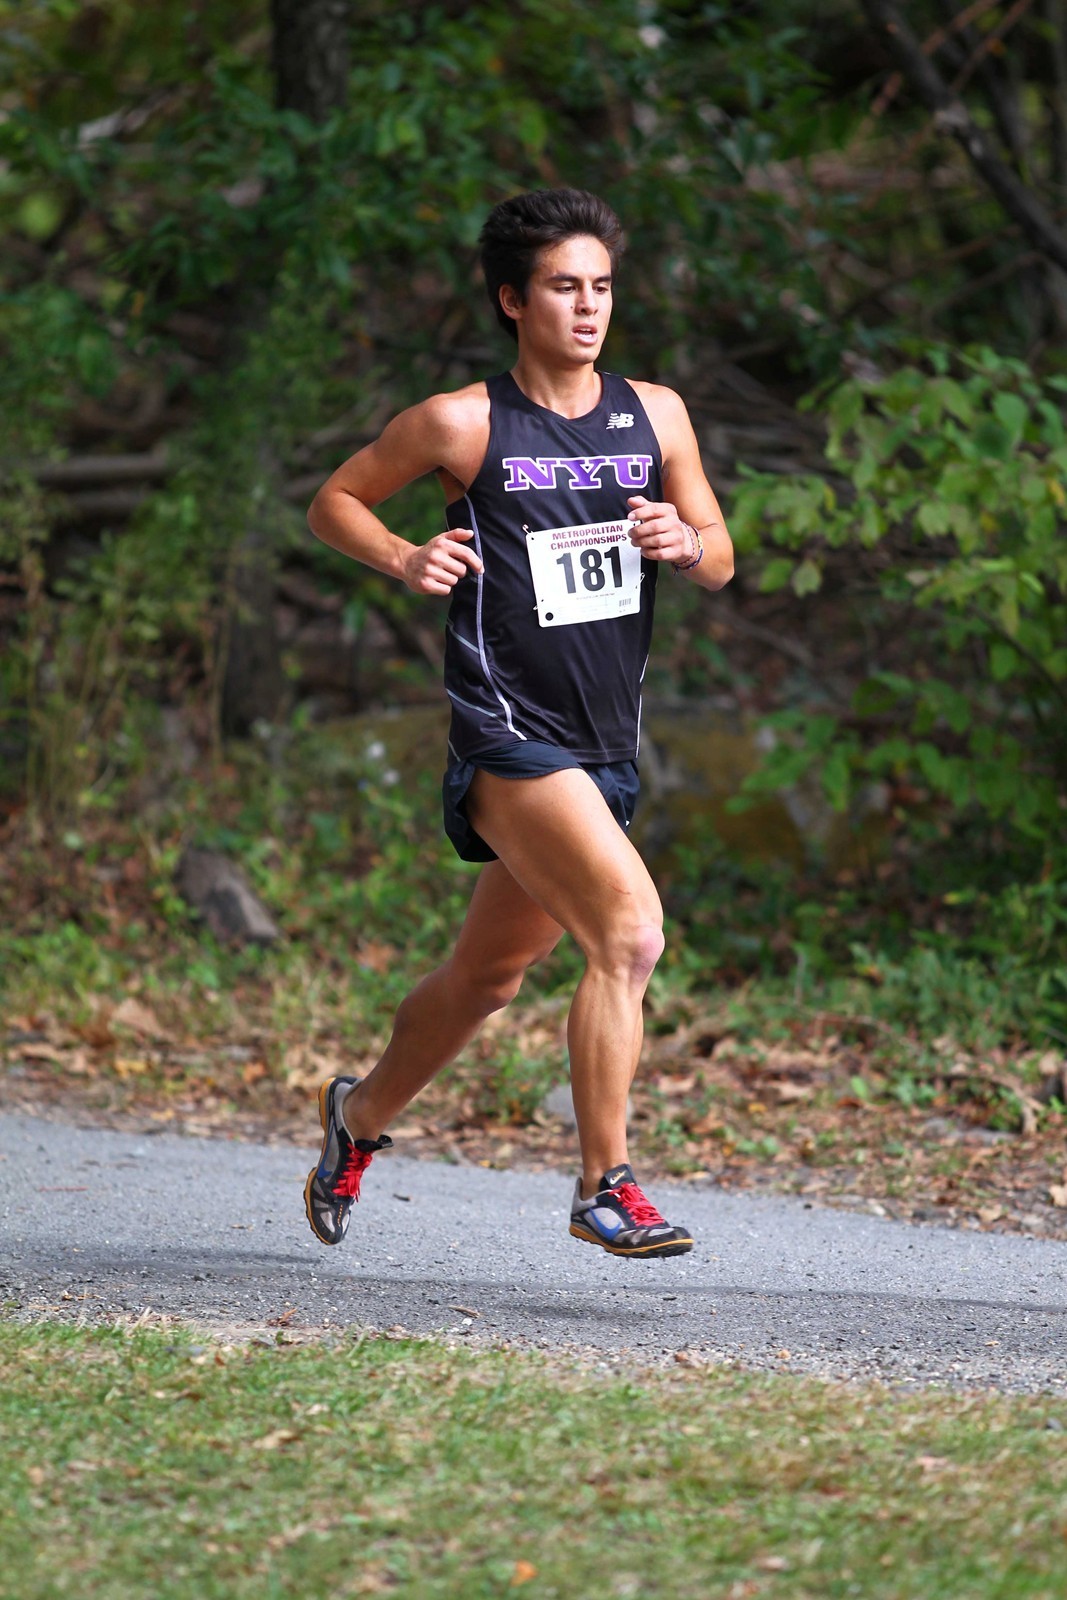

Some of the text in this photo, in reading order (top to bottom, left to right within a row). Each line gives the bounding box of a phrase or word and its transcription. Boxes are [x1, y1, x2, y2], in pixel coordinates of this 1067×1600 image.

[502, 455, 653, 492] NYU
[550, 534, 627, 550] CHAMPIONSHIPS
[552, 525, 623, 540] METROPOLITAN
[556, 546, 622, 594] 181
